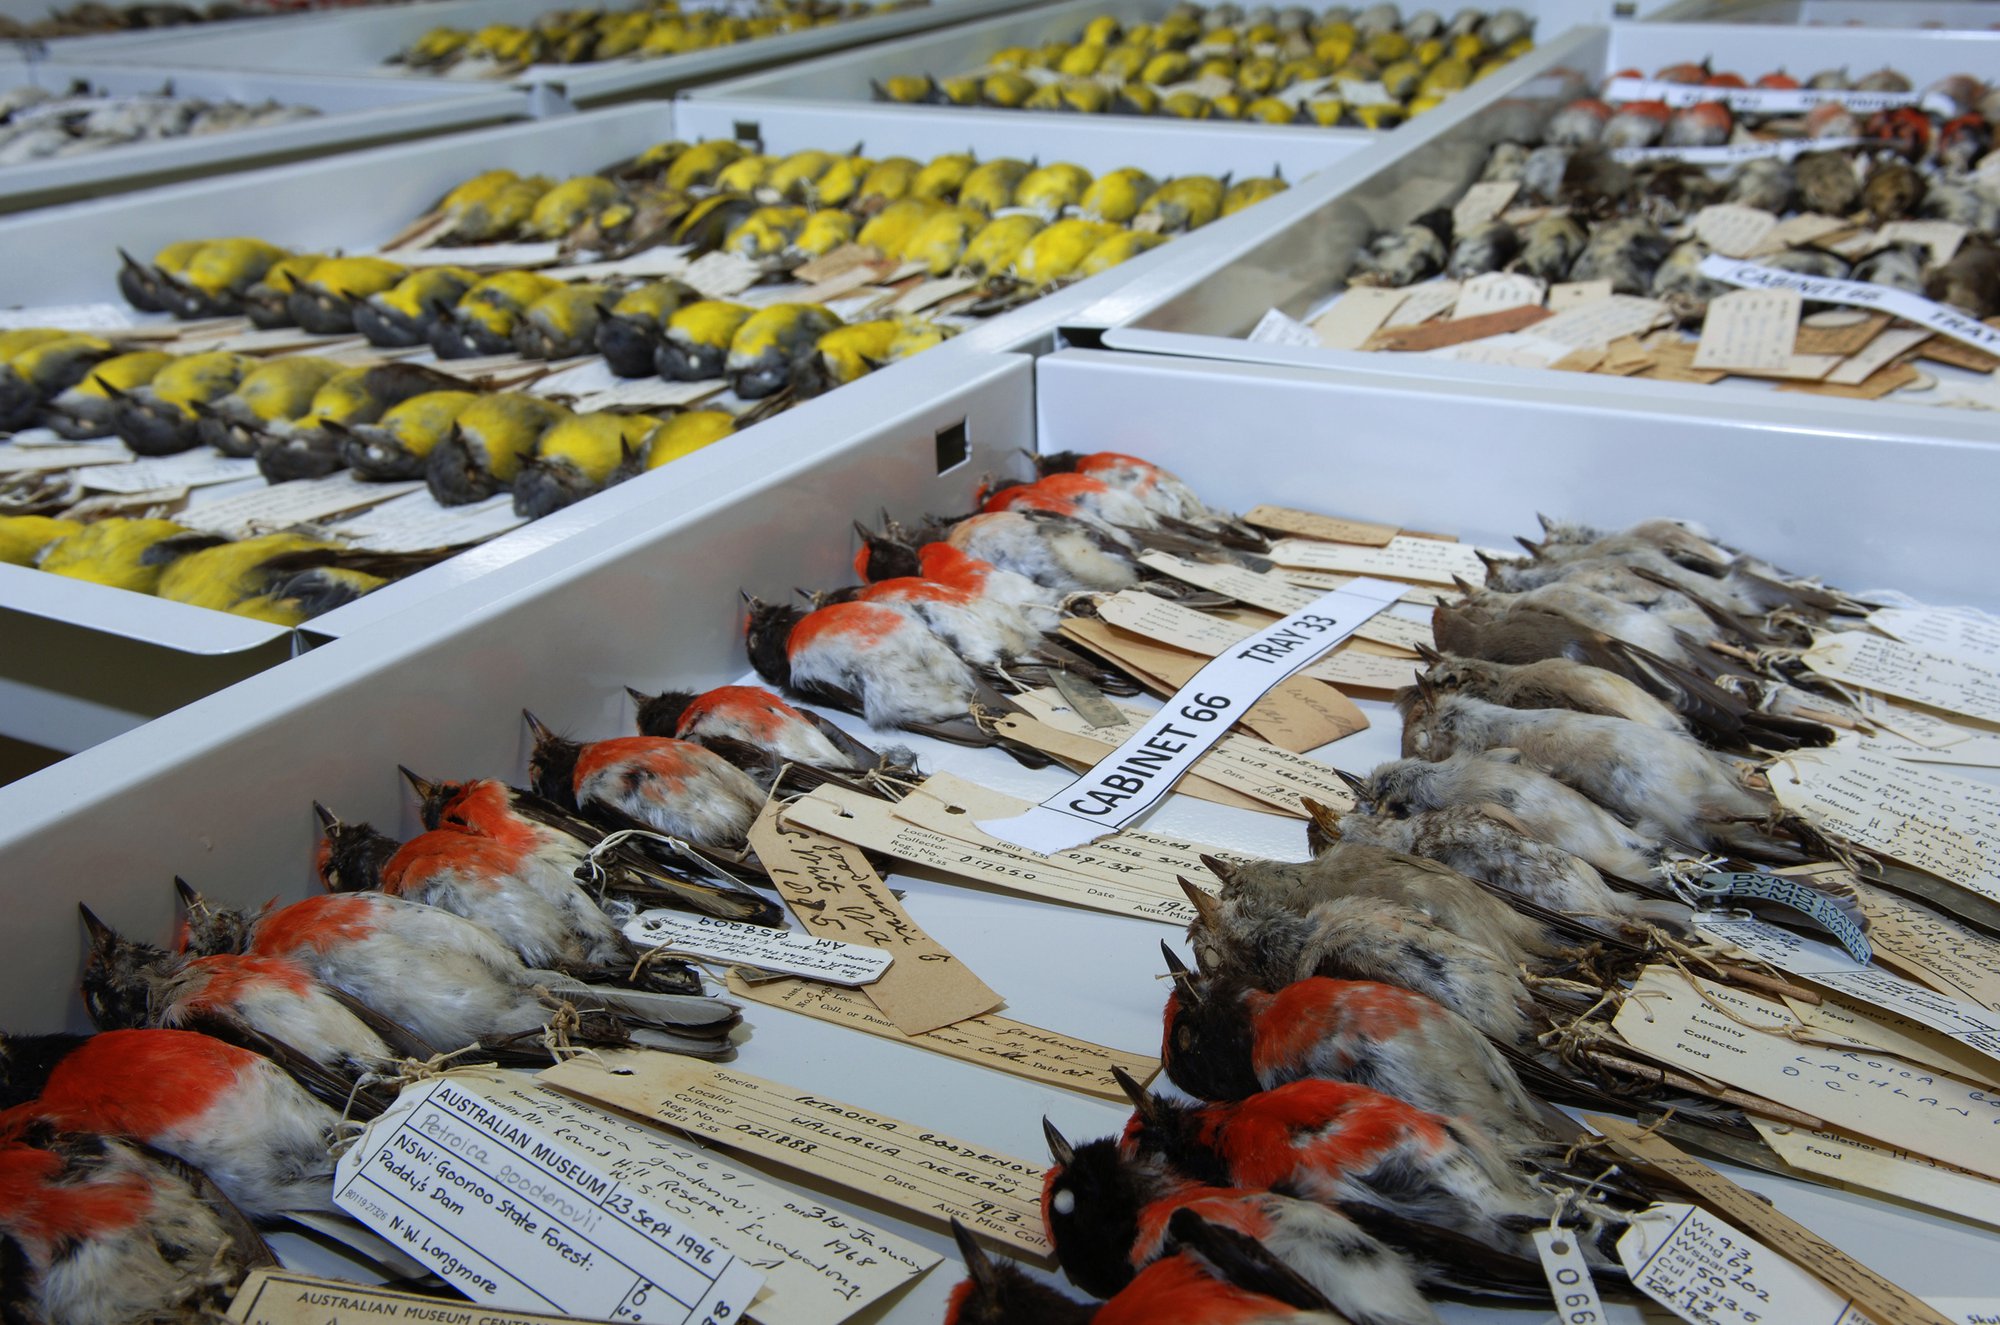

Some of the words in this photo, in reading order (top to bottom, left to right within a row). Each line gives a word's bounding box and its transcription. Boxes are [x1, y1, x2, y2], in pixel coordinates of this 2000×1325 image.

[1069, 722, 1198, 817] CABINET
[1179, 691, 1232, 723] 66
[1237, 628, 1310, 664] TRAY
[1292, 614, 1337, 633] 33
[1222, 769, 1245, 781] Date
[1839, 775, 1869, 790] Name
[1850, 768, 1880, 782] AUST.
[1888, 783, 1912, 796] MUS.
[1814, 793, 1861, 816] Collector
[1826, 783, 1867, 802] Locality
[896, 833, 949, 852] Collector
[903, 828, 946, 844] Locality
[996, 841, 1022, 853] 14013
[890, 840, 914, 852] Reg.
[920, 846, 940, 858] No.
[892, 848, 919, 859] 14013
[1087, 887, 1116, 899] Date
[1732, 881, 1814, 906] DYMO
[1733, 873, 1817, 899] DYMO
[1133, 904, 1165, 916] Aust.
[1729, 888, 1812, 912] DYMO
[815, 938, 847, 952] AM
[1939, 953, 1984, 980] Collector
[832, 993, 854, 1004] Loc.
[1706, 988, 1750, 1009] AUST.
[1756, 1005, 1795, 1025] MUS.
[820, 1003, 842, 1014] Coll.
[846, 1010, 860, 1018] or
[863, 1014, 895, 1028] Donor
[1691, 1014, 1746, 1038] Locality
[1676, 1042, 1711, 1060] Food
[1683, 1028, 1748, 1055] Collector
[1033, 1062, 1059, 1074] Date
[713, 1071, 760, 1091] Species
[568, 1101, 594, 1116] MUS.
[599, 1115, 617, 1127] No.
[674, 1093, 734, 1116] Collector
[510, 1090, 539, 1106] Name
[536, 1101, 632, 1152] Petroica
[420, 1113, 491, 1165] Petroica
[484, 1095, 521, 1116] Locality
[612, 1159, 651, 1177] Hill
[661, 1099, 683, 1114] Reg.
[692, 1109, 716, 1123] No.
[883, 1174, 918, 1191] Date
[687, 1085, 738, 1106] Locality
[917, 1160, 1016, 1195] NEPEAN
[1810, 1129, 1878, 1152] Collector
[1805, 1145, 1843, 1161] Food
[378, 1149, 430, 1193] Paddy's
[429, 1187, 465, 1216] Dam
[436, 1087, 533, 1150] AUSTRALIAN
[530, 1142, 608, 1197] MUSEUM
[606, 1193, 634, 1215] 23
[631, 1209, 673, 1238] Sept
[676, 1234, 715, 1264] 1996
[657, 1109, 689, 1123] 14013
[696, 1122, 721, 1134] 5.55
[932, 1202, 970, 1220] Aust.
[975, 1216, 1009, 1235] Mus.
[1014, 1230, 1048, 1249] Coll.
[995, 1173, 1022, 1187] Sex
[393, 1134, 438, 1166] NSW:
[436, 1160, 494, 1205] Goonoo
[496, 1199, 537, 1234] State
[541, 1227, 594, 1272] Forest:
[784, 1203, 811, 1218] Date
[849, 1228, 925, 1276] January
[1684, 1227, 1724, 1259] Wing
[1726, 1257, 1755, 1276] 67
[1691, 1217, 1713, 1237] Wt
[1719, 1236, 1753, 1261] 9.3
[823, 1239, 878, 1266] 1968
[421, 1237, 498, 1295] Longmore
[1657, 1256, 1685, 1278] Cul
[1667, 1245, 1695, 1268] Tail
[1696, 1265, 1727, 1289] 50
[1676, 1236, 1729, 1276] Wspan
[1729, 1273, 1770, 1304] 202
[1650, 1265, 1675, 1287] Tar
[1678, 1286, 1719, 1313] 19.8
[297, 1291, 397, 1316] AUSTRALIAN
[403, 1306, 472, 1325] MUSEUM
